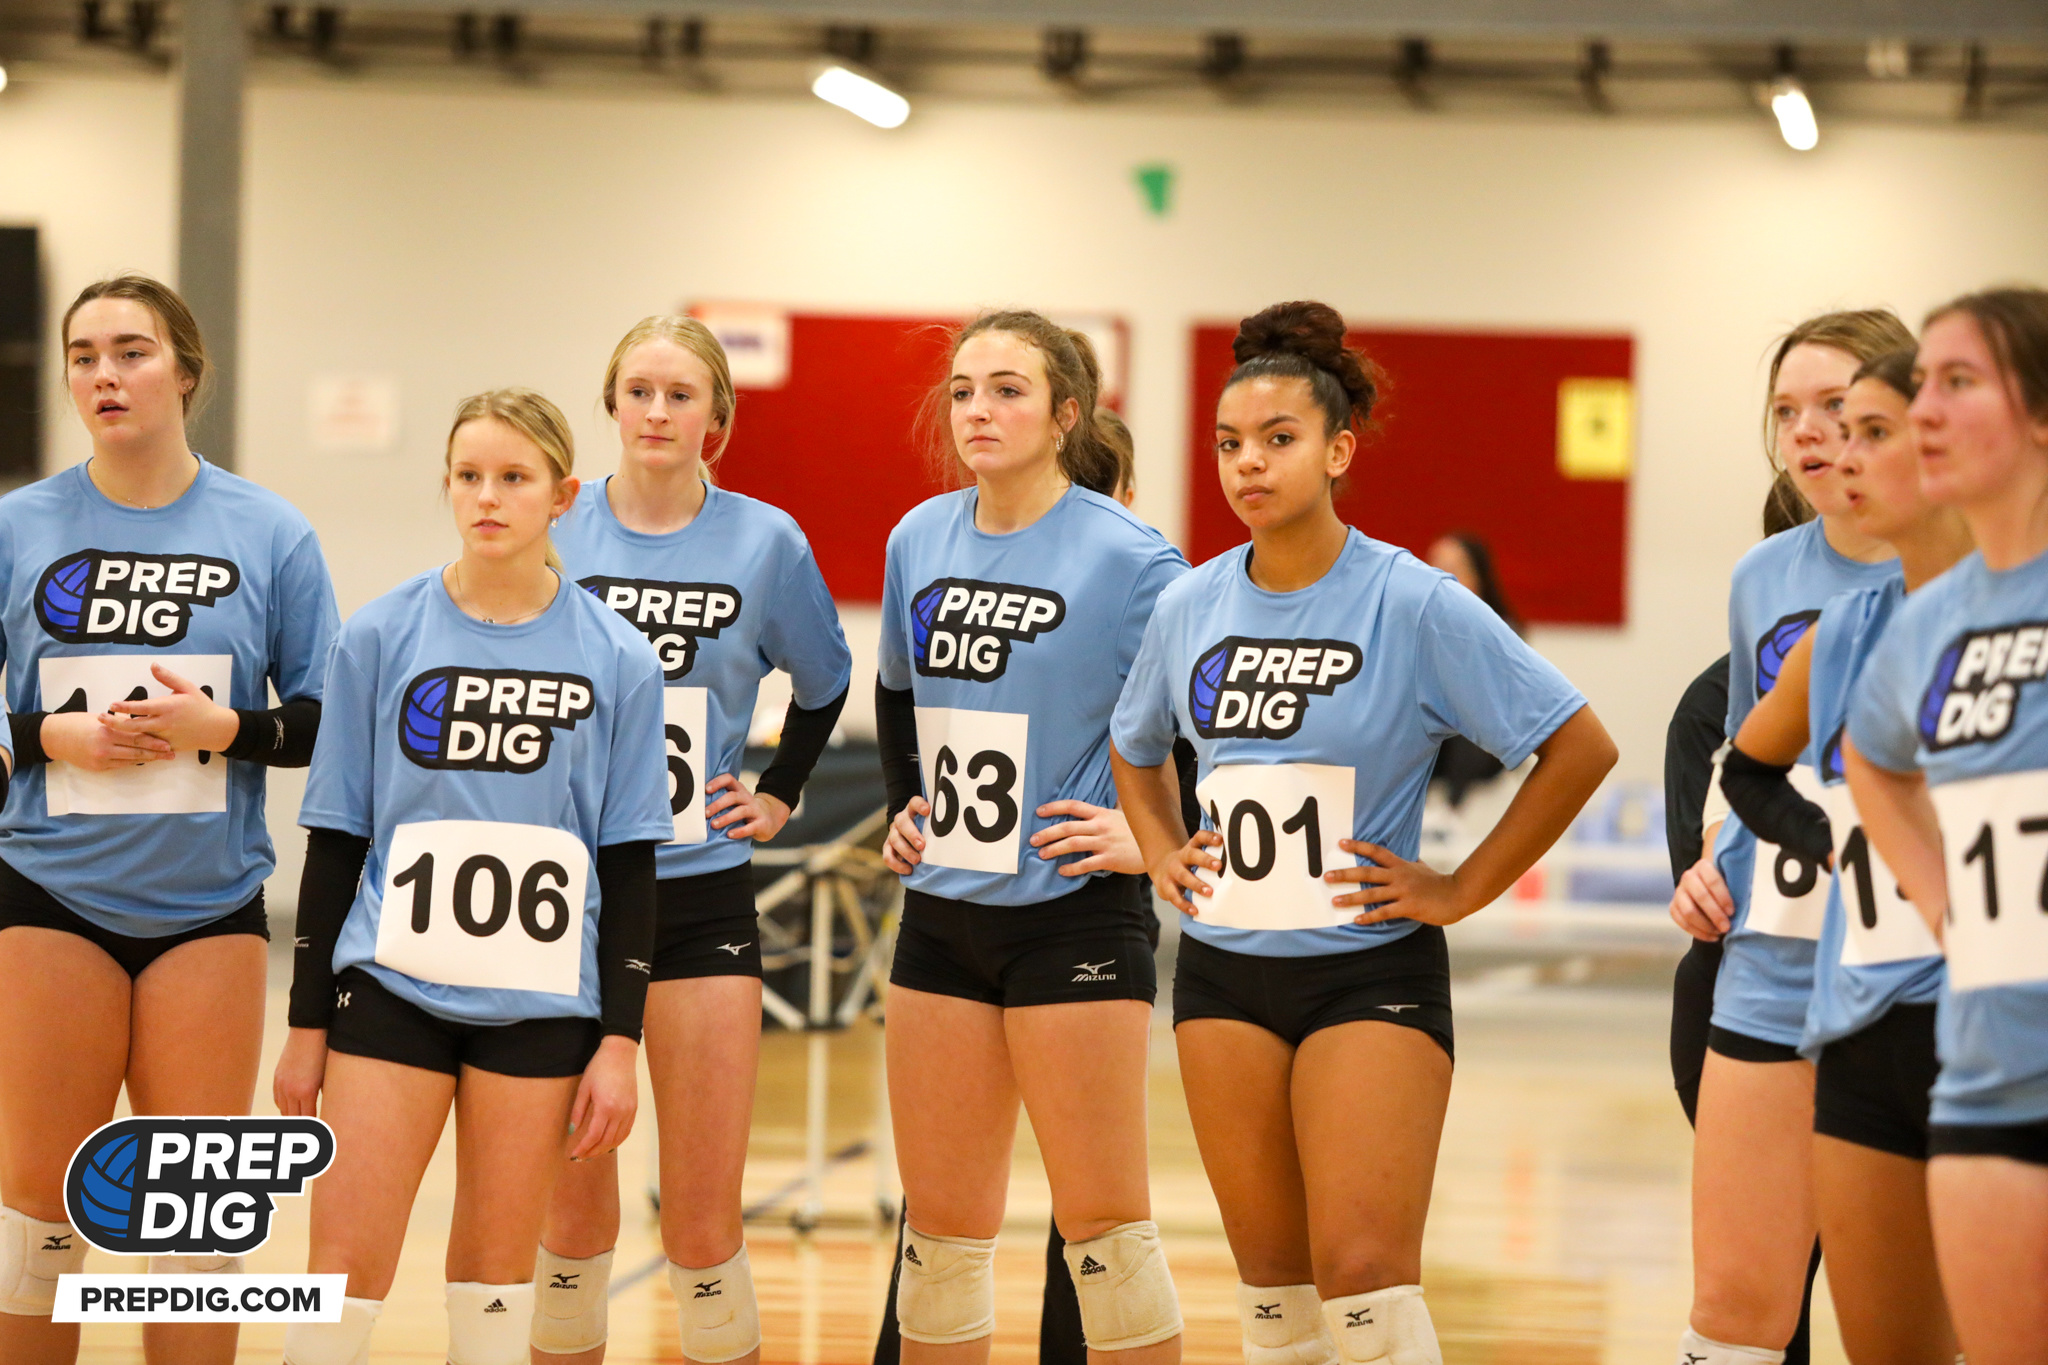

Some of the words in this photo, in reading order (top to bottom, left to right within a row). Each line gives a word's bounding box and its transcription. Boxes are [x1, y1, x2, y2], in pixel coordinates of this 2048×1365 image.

[95, 559, 231, 597] PREP
[86, 599, 181, 637] DIG
[606, 586, 735, 628] PREP
[937, 586, 1058, 632] PREP
[929, 631, 1001, 673] DIG
[1226, 646, 1354, 686] PREP
[453, 676, 591, 719] PREP
[1215, 691, 1298, 730] DIG
[1935, 682, 2015, 745] DIG
[446, 721, 542, 764] DIG
[930, 745, 1018, 843] 63
[1210, 796, 1322, 881] 01
[393, 852, 570, 943] 106
